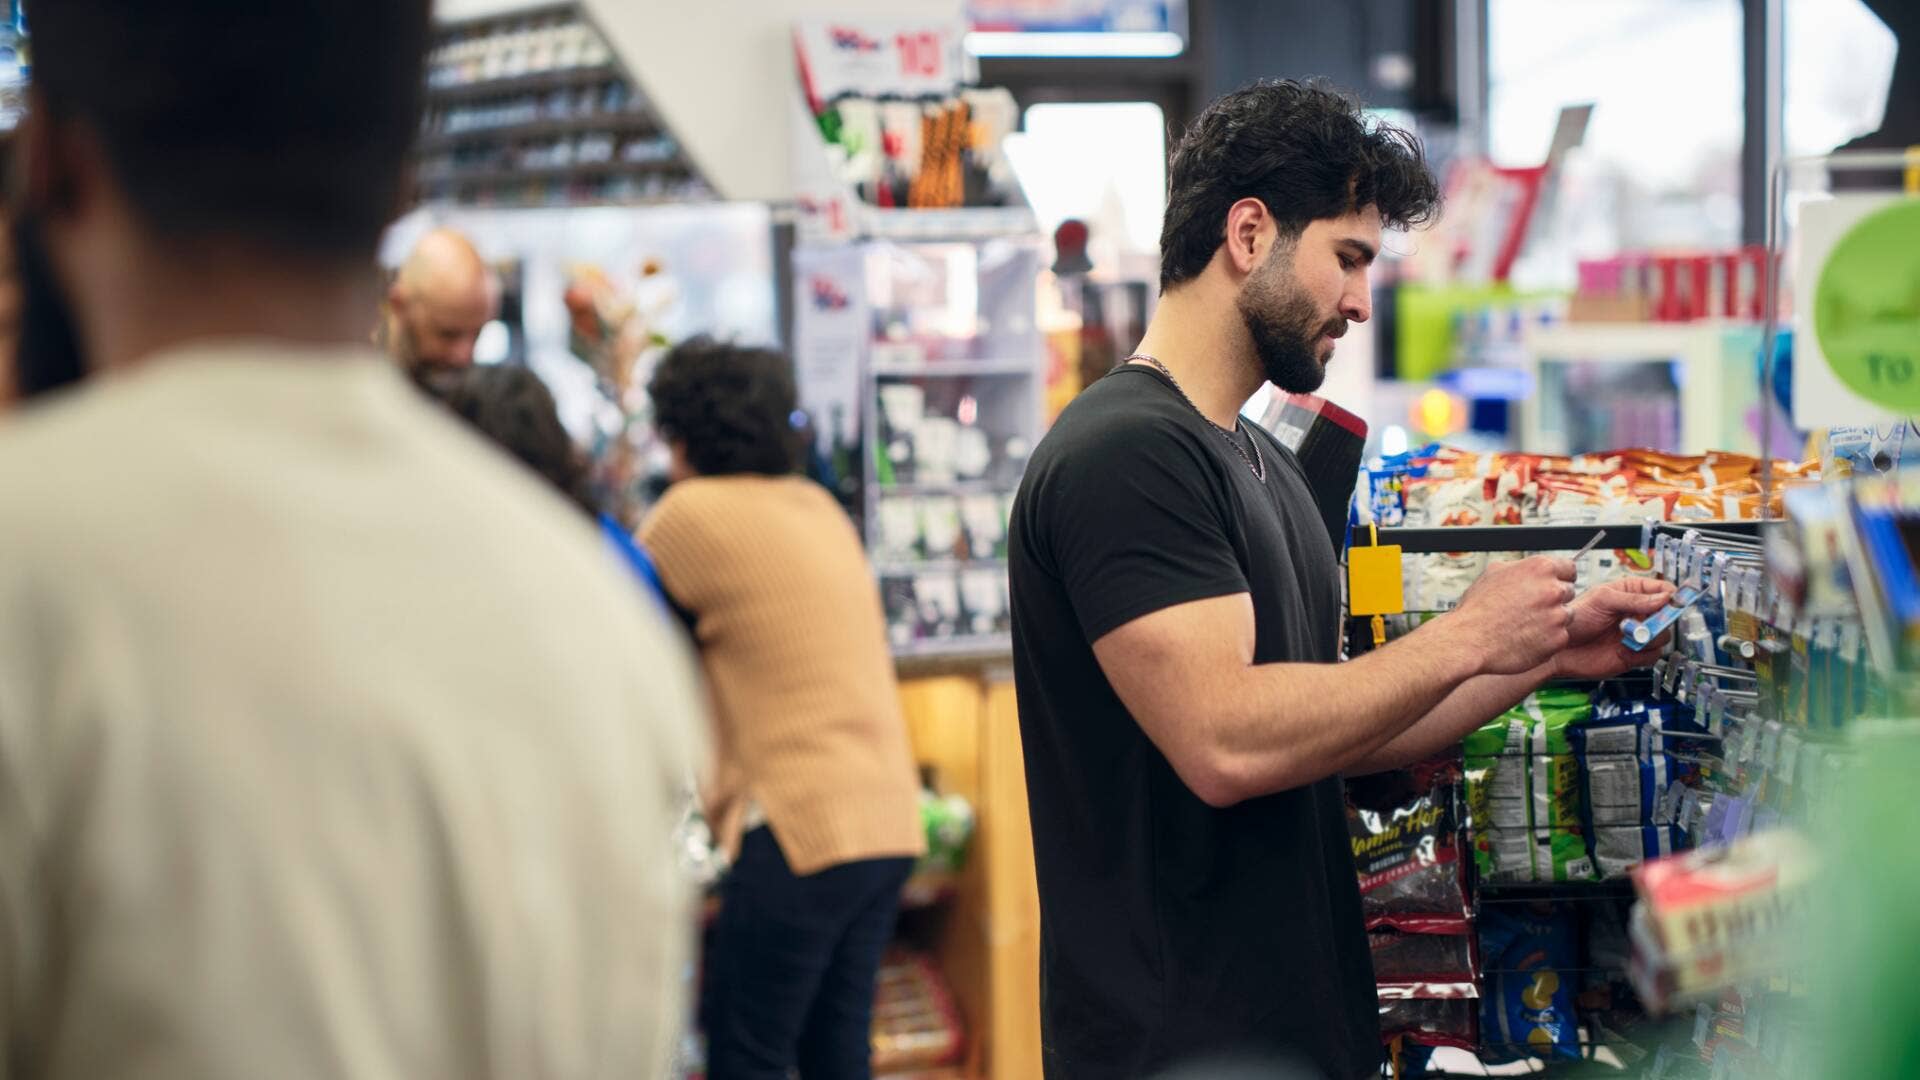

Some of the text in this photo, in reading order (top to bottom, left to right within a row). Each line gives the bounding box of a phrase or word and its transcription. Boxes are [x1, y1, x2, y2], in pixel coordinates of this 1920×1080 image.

[1406, 806, 1444, 833] Hot
[1369, 852, 1405, 872] ORIGINAL
[1386, 861, 1417, 881] JERKY
